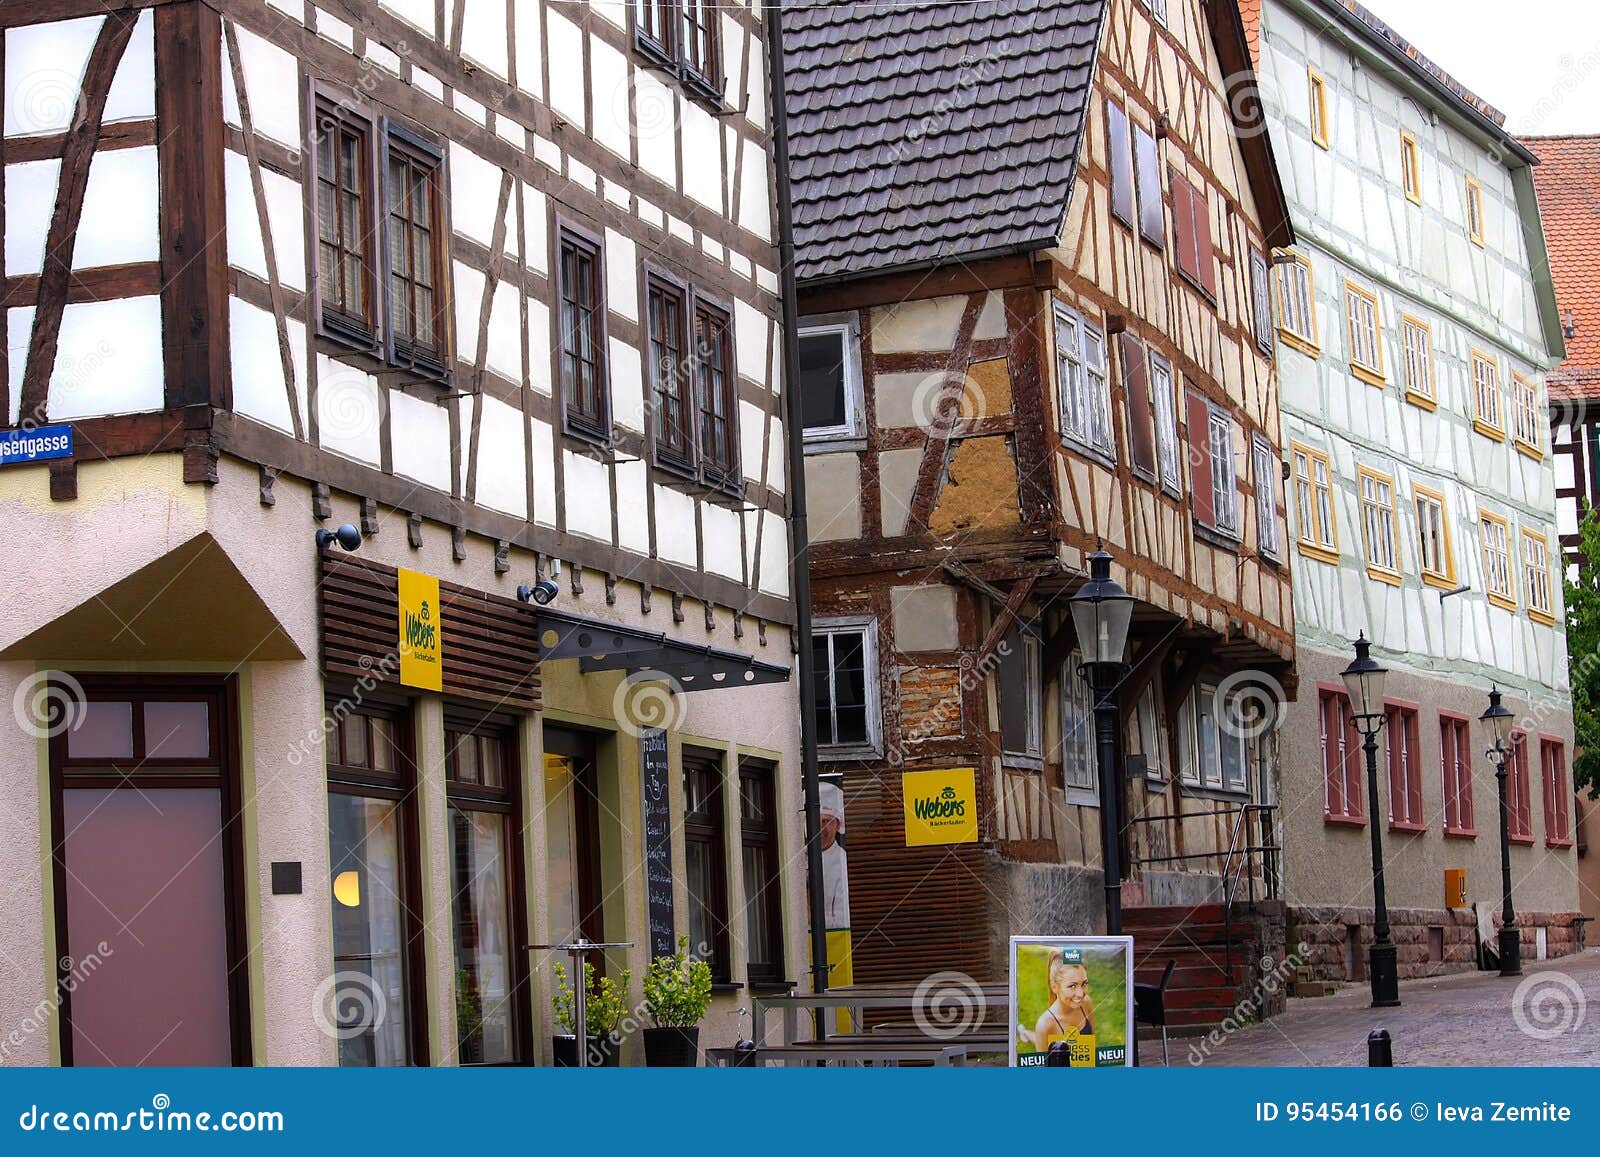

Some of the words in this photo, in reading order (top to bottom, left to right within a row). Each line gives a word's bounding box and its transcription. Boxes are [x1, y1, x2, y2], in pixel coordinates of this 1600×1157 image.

[406, 609, 435, 650] Webers
[914, 796, 966, 820] Webers
[1020, 1056, 1045, 1067] NEU!
[1098, 1049, 1124, 1061] NEU!
